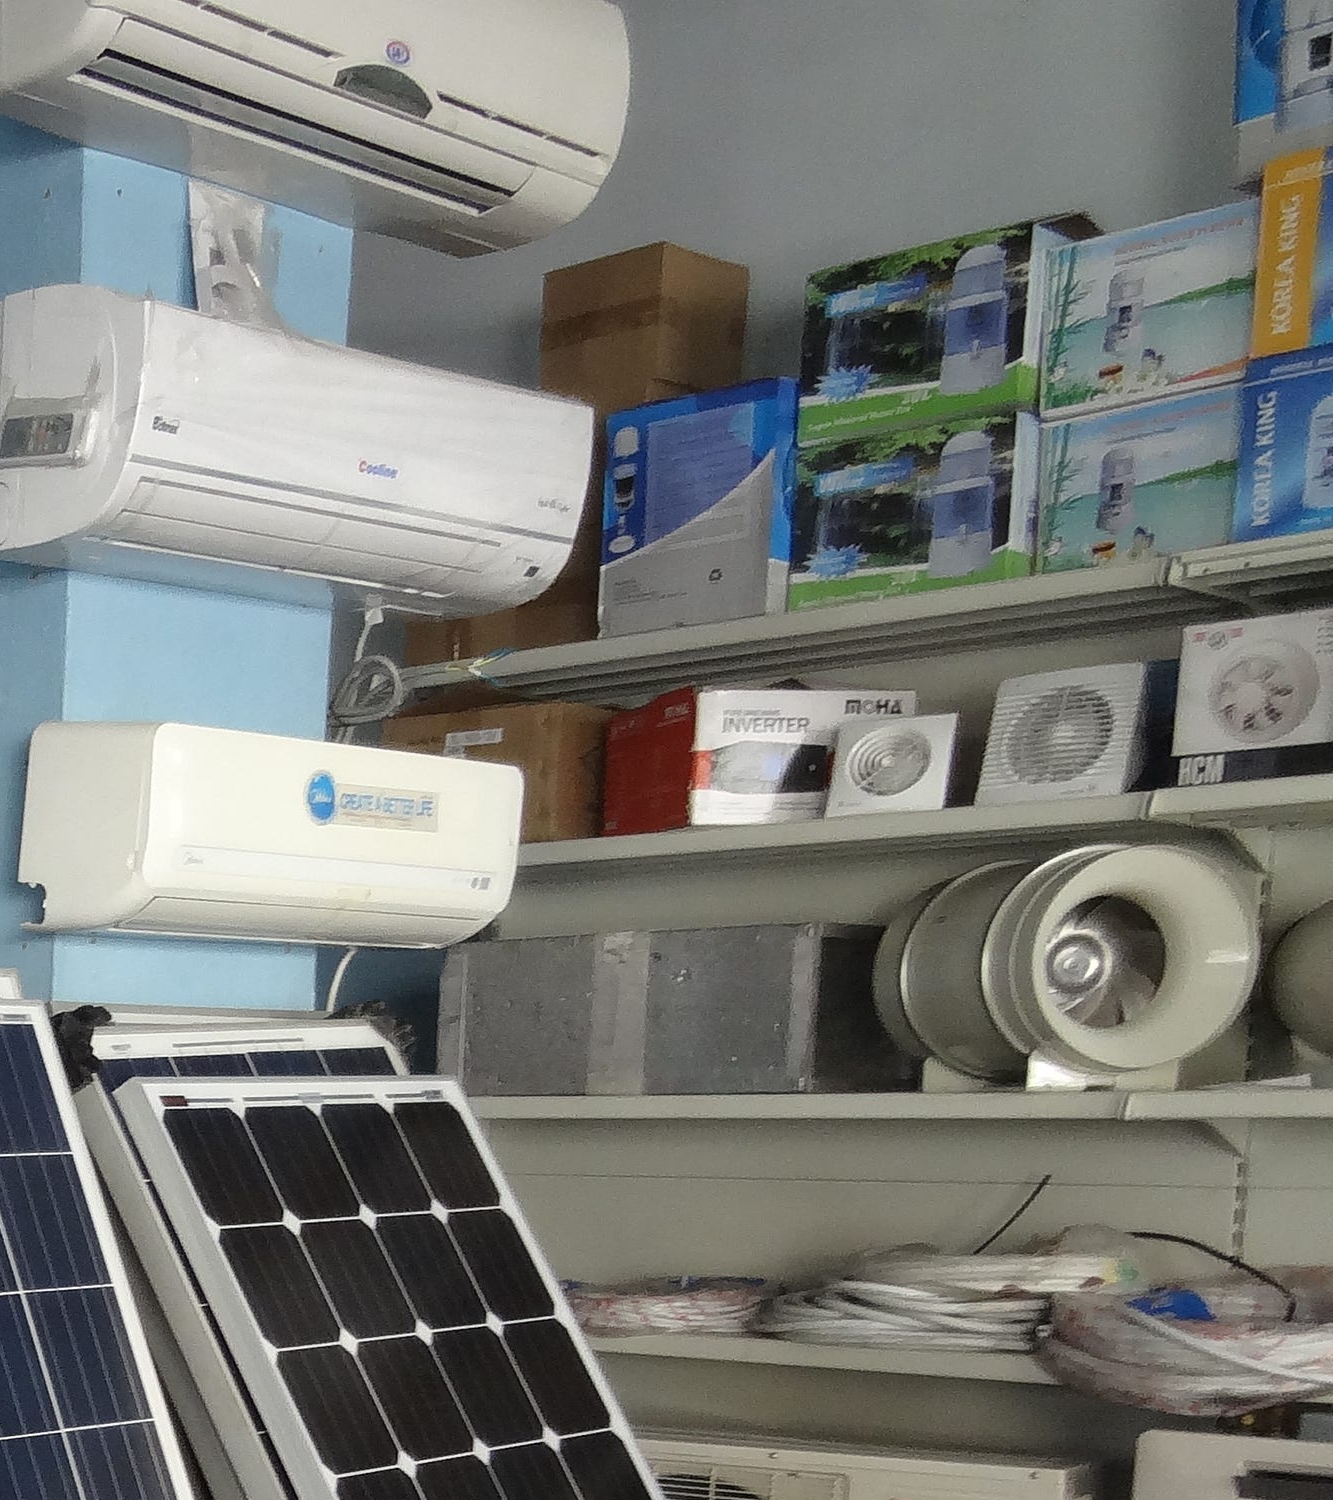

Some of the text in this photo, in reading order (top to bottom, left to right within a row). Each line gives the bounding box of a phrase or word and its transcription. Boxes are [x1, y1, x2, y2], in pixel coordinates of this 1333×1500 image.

[1278, 193, 1304, 253] KING
[1254, 389, 1278, 448] KING
[358, 458, 398, 480] Cooline
[721, 716, 812, 735] INVERTER
[1177, 753, 1226, 787] HCM
